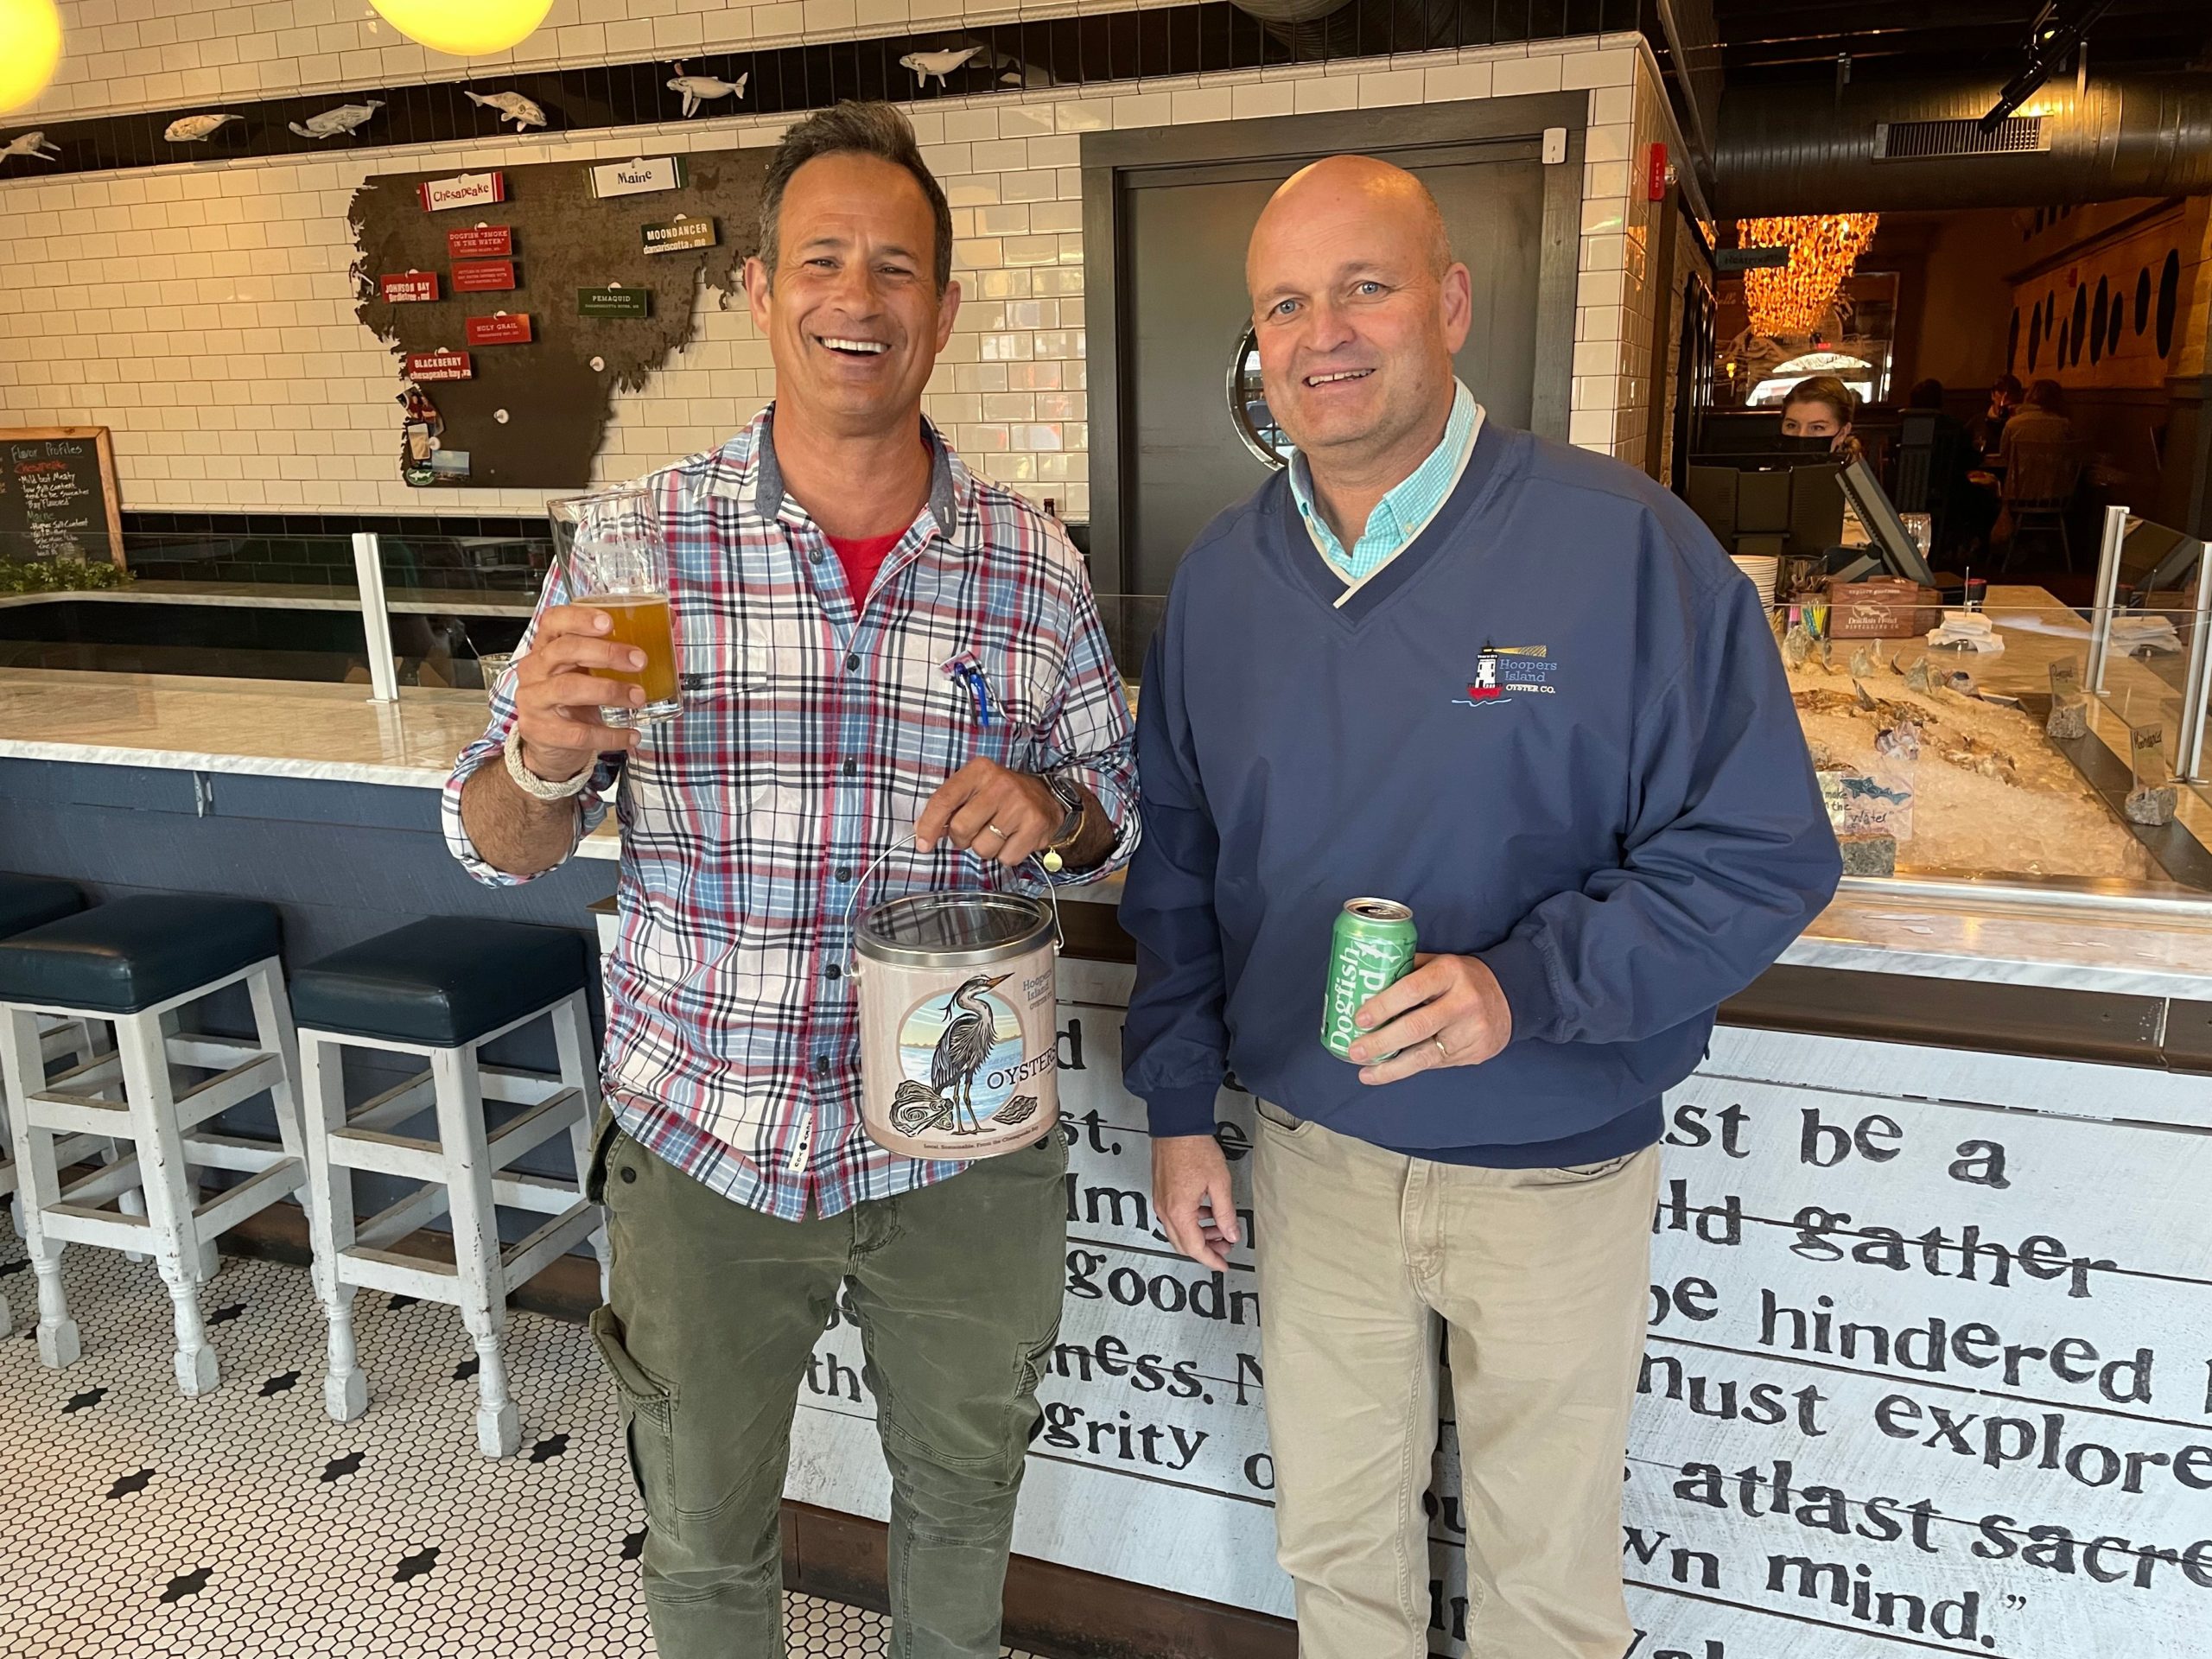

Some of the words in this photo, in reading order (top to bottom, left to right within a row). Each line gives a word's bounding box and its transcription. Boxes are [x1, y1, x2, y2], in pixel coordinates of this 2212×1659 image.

[618, 171, 652, 185] Maine
[433, 183, 489, 202] Chesapeake
[449, 232, 479, 240] DOGFISH
[647, 223, 708, 240] MOONDANCER
[385, 283, 415, 294] JOHNSON
[416, 282, 430, 292] BAY
[414, 357, 461, 368] BLACKBERRY
[1500, 659, 1558, 673] Hoopers
[1504, 671, 1546, 683] Island
[1505, 683, 1540, 693] OYSTER
[1540, 685, 1556, 694] CO.
[1330, 946, 1361, 1053] Dogfish
[1801, 1108, 1904, 1167] be
[1948, 1139, 2011, 1189] a
[1789, 1205, 2118, 1298] gather
[1065, 1249, 1262, 1326] goodn
[1758, 1287, 2154, 1405] hindered
[1046, 1335, 1214, 1405] ness.
[1874, 1394, 2212, 1494] explore
[1044, 1402, 1211, 1471] grity
[1623, 1525, 1721, 1590] wn
